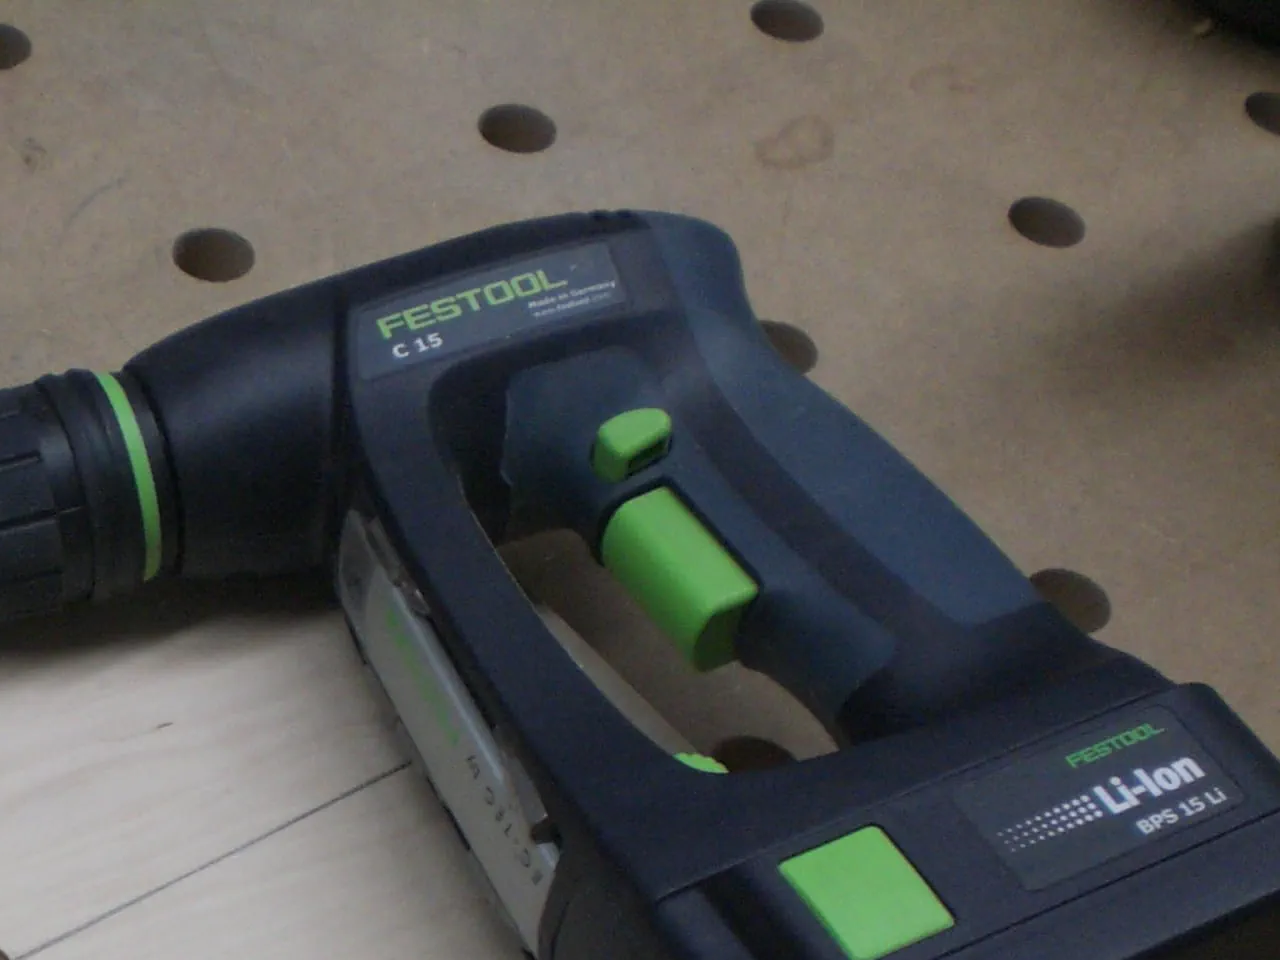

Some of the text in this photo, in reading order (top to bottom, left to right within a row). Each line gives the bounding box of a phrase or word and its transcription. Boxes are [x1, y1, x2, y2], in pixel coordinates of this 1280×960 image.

[376, 269, 568, 339] FESTOOL
[392, 332, 443, 358] C 15
[1065, 723, 1167, 768] FESTOOL
[1093, 757, 1206, 814] Li-Ion
[1136, 787, 1228, 835] BPS 15 Li
